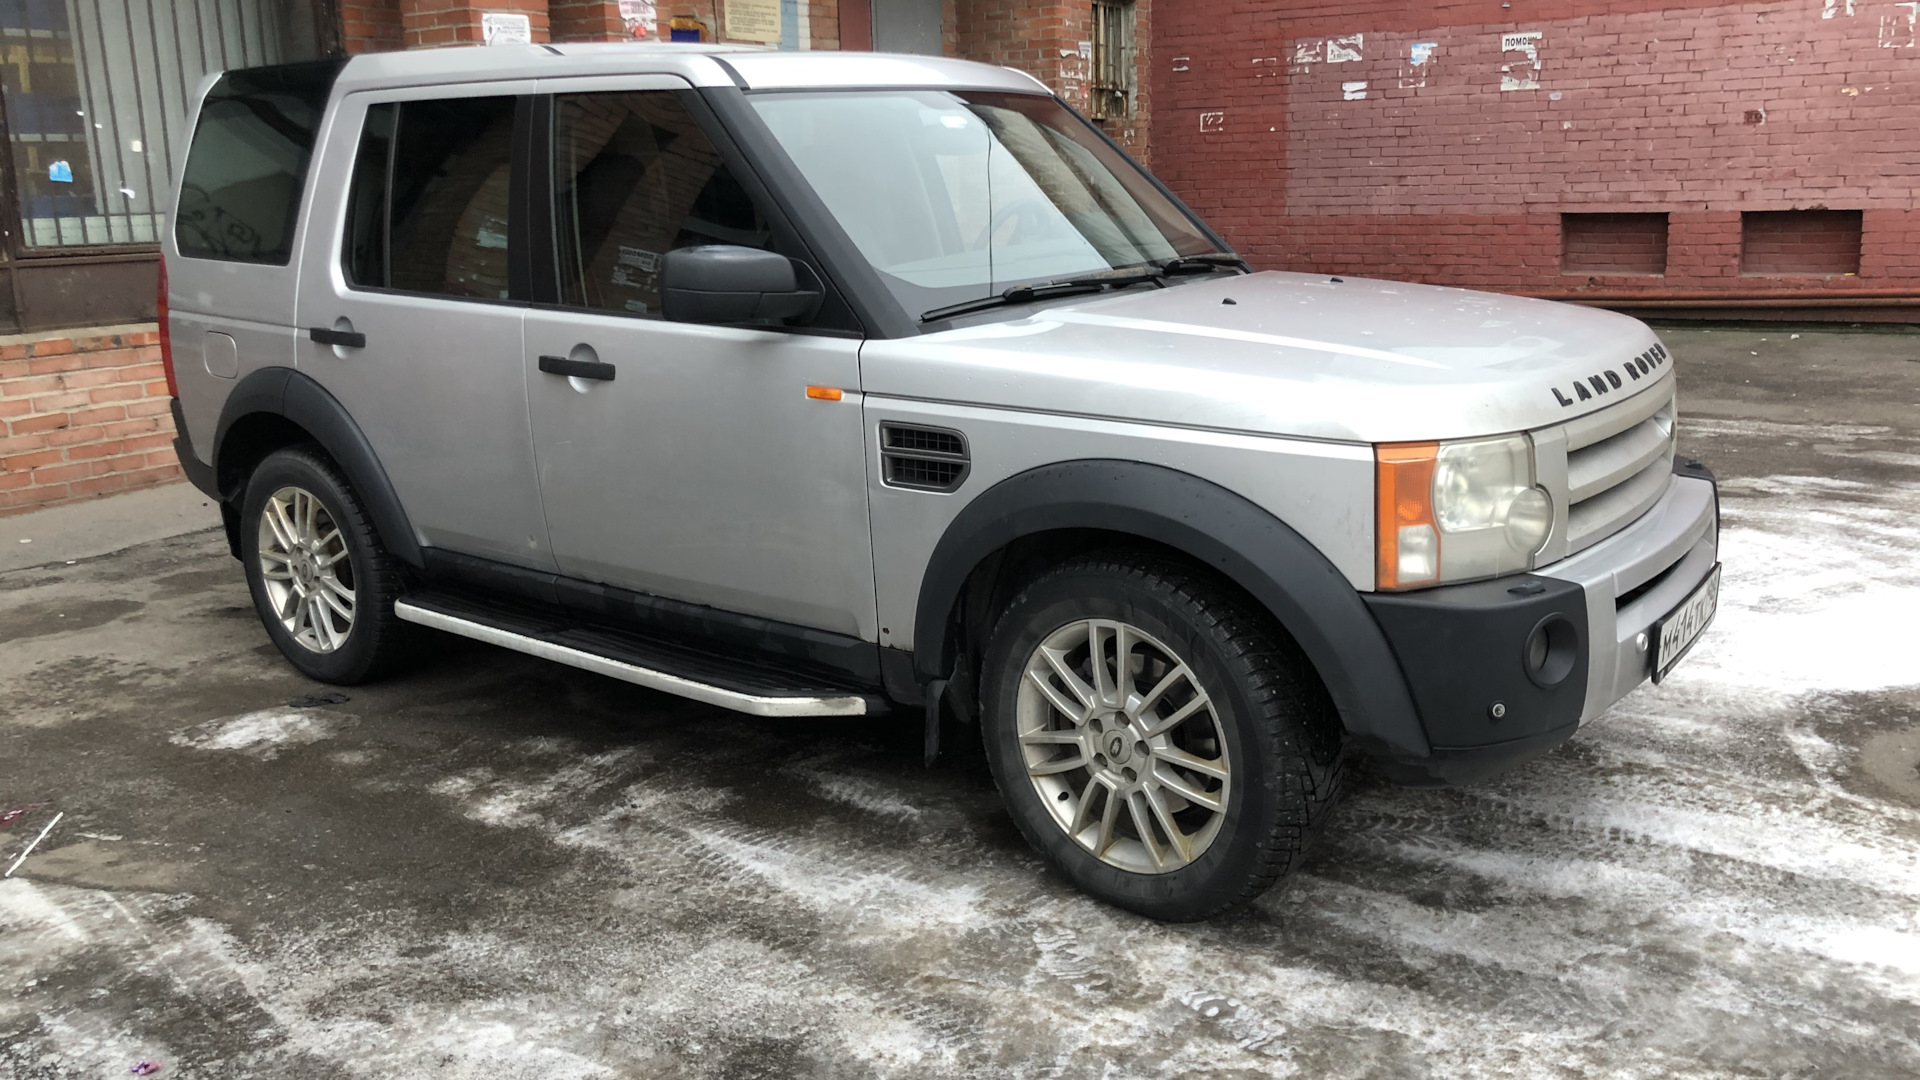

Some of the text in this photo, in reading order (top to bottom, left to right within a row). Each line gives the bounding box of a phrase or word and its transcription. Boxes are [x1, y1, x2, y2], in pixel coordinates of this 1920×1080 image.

[1505, 36, 1538, 47] ПОМО
[1551, 343, 1667, 407] LAND ROVER
